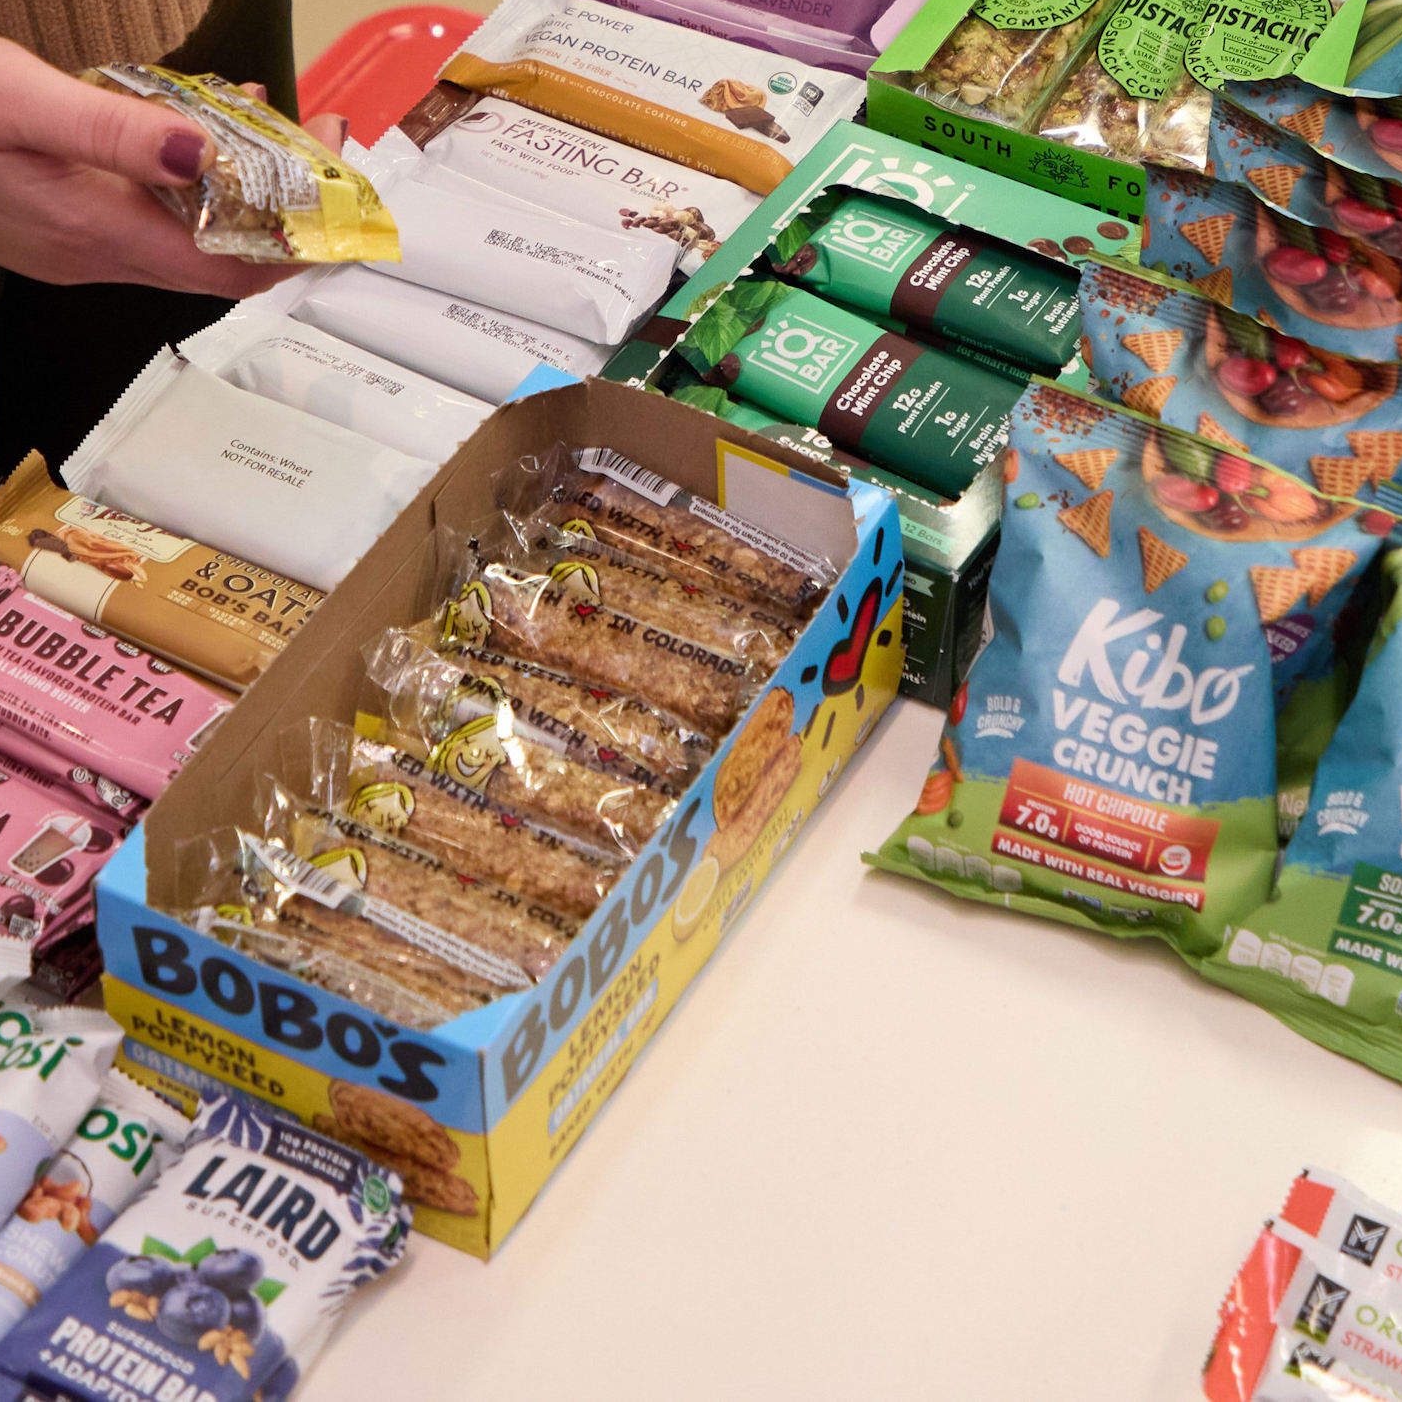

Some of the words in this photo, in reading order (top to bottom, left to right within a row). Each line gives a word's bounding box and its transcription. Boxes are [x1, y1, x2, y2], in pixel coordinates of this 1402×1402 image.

[577, 10, 634, 35] POWER
[580, 39, 662, 79] PROTEIN
[662, 71, 703, 94] BAR
[518, 117, 609, 154] INTERMITTENT
[585, 84, 642, 112] CHOCOLATE
[644, 105, 688, 128] COATING
[502, 121, 623, 178] FASTING
[621, 167, 681, 199] BAR
[922, 114, 1013, 159] SOUTH
[798, 337, 848, 383] BAR
[836, 350, 890, 412] Chocolate
[850, 382, 881, 417] Mint
[876, 358, 903, 387] Chip
[220, 448, 249, 468] NOT
[249, 460, 270, 475] FOR
[264, 466, 306, 490] RESALE
[229, 437, 279, 466] Contains:
[278, 458, 314, 479] Wheat
[607, 614, 639, 639] IN
[641, 626, 746, 679] COLORADO
[1057, 597, 1255, 726] Kibo
[3, 648, 21, 666] TEA
[21, 654, 73, 694] FLAVORED
[73, 685, 116, 717] PROTEIN
[116, 706, 142, 727] BAR
[119, 676, 185, 727] TEA
[1051, 689, 1220, 780] VEGGIE
[1053, 737, 1194, 808] CRUNCH
[1063, 781, 1094, 808] HOT
[1096, 792, 1168, 833] CHIPOTLE
[502, 797, 701, 1104] BOBO'S
[1335, 935, 1380, 964] MADE
[132, 926, 447, 1103] BOBO'S
[155, 1009, 255, 1068] LEMON
[131, 1016, 285, 1099] POPPYSEED
[183, 1155, 342, 1263] LAIRD
[185, 1201, 303, 1271] SUPERFOOD
